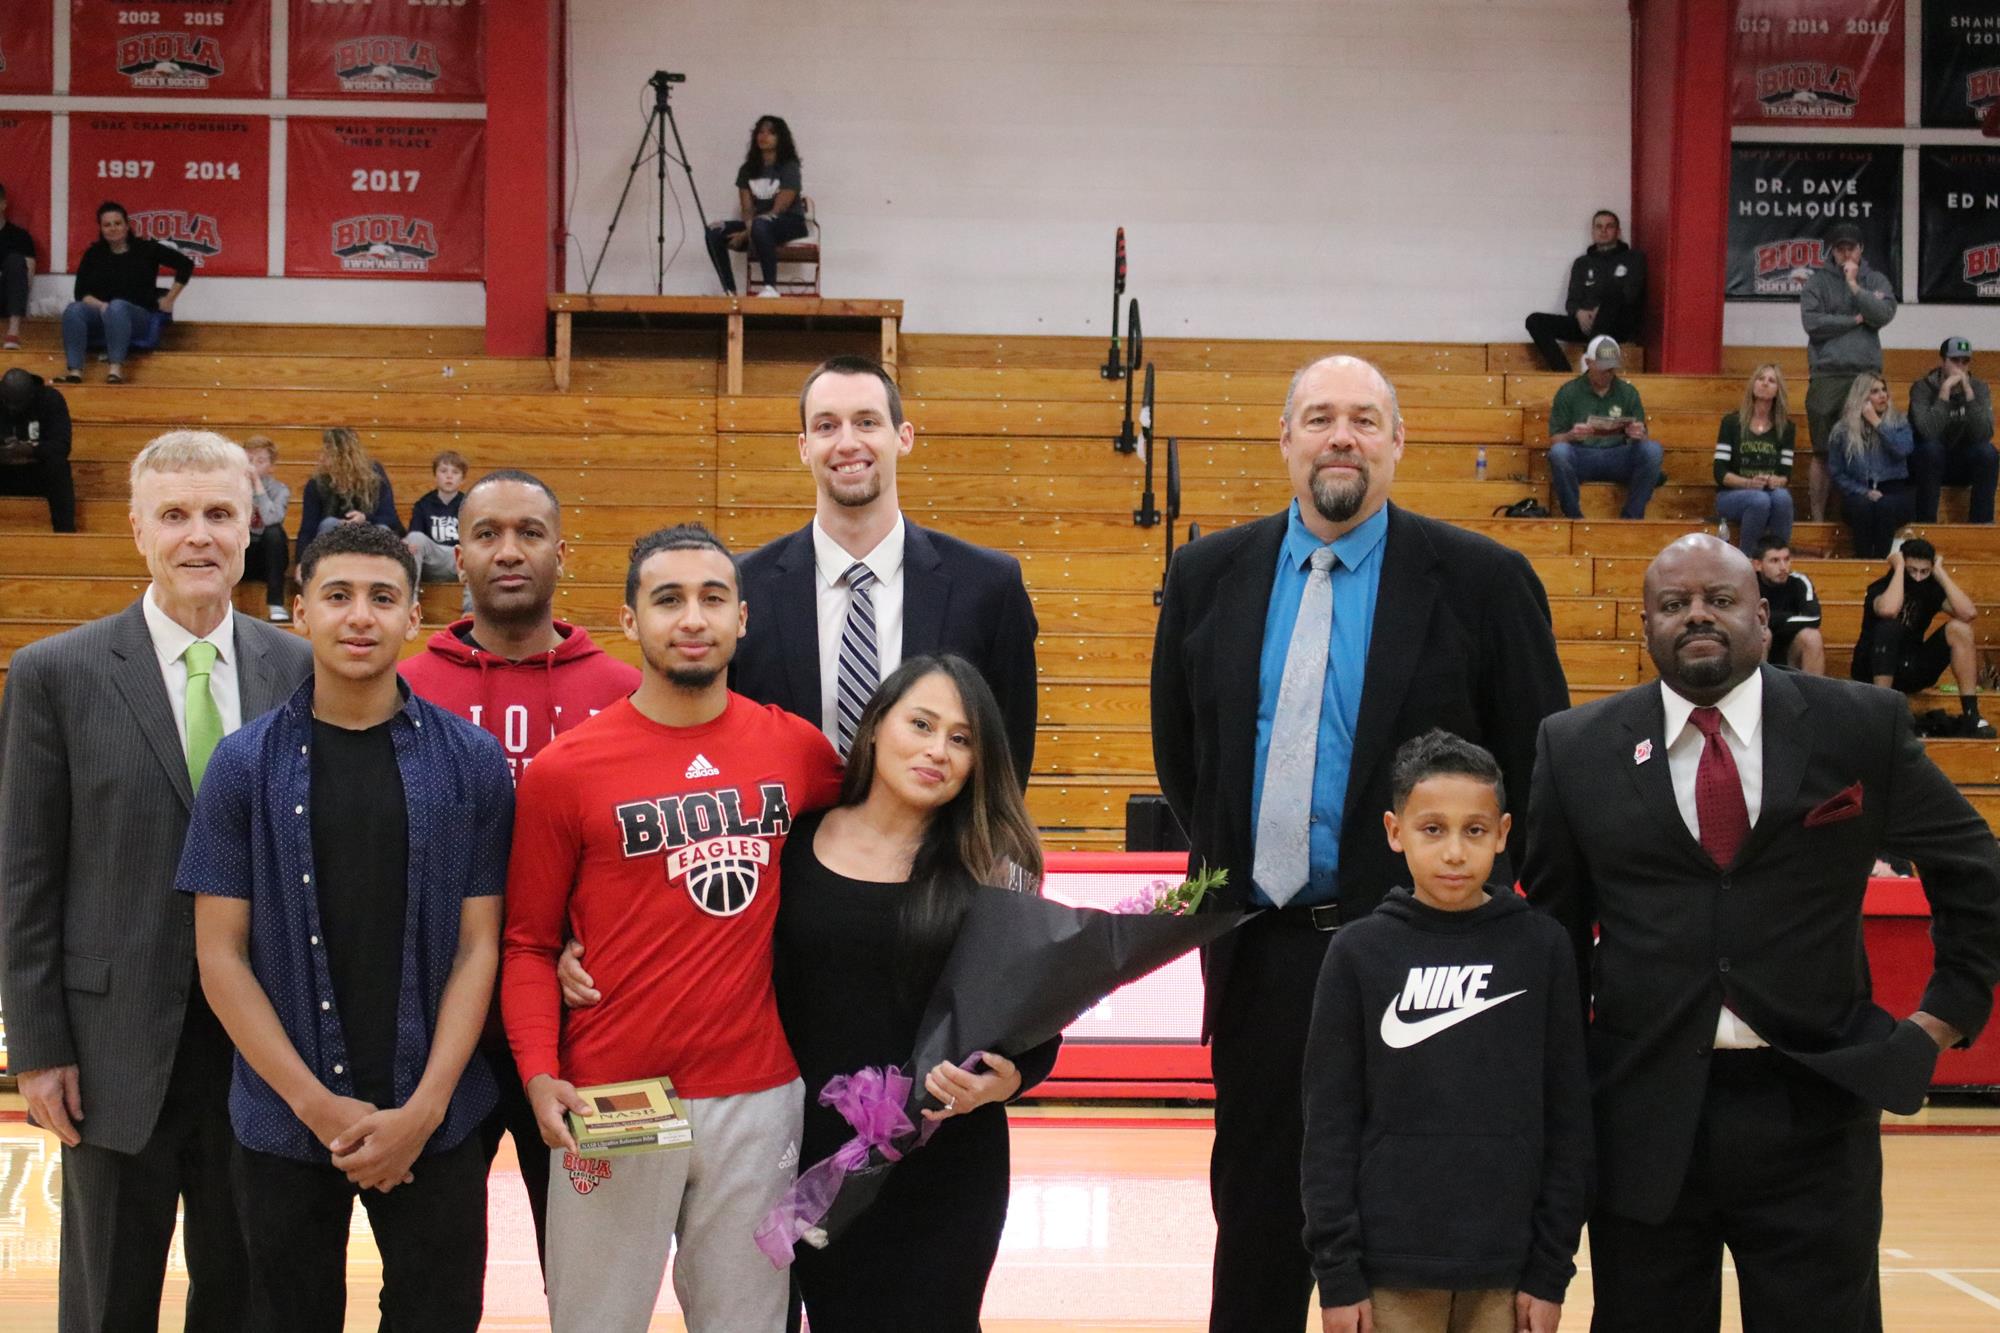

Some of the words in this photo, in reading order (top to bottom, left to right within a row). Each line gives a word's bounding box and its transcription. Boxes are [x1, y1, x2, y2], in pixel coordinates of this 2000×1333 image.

[118, 11, 161, 25] 2002
[184, 12, 225, 26] 2015
[1738, 18, 1772, 33] 013
[1787, 19, 1830, 34] 2014
[118, 33, 223, 69] BIOLA
[336, 37, 439, 71] BIOLA
[166, 78, 207, 88] SOCCER
[1757, 63, 1857, 99] BIOLA
[1765, 106, 1799, 116] TRACK
[1800, 106, 1823, 116] AND
[1824, 106, 1853, 116] FIELD
[132, 121, 248, 133] CHAMPIONSHIPS
[97, 160, 155, 178] 1997
[185, 162, 241, 180] 2014
[351, 169, 421, 192] 2017
[1755, 178, 1792, 194] DR.
[1803, 179, 1857, 195] DAVE
[1738, 201, 1873, 219] HOLMQUIST
[1947, 193, 1975, 209] ED
[332, 215, 438, 252] BIOLA
[1757, 239, 1827, 276] BIOL
[685, 766, 720, 779] adidas
[614, 782, 793, 858] BIOLA
[679, 840, 762, 870] EAGLES
[1398, 964, 1494, 1012] NIKE
[599, 1108, 657, 1120] NASB
[563, 1152, 611, 1178] BIOLA
